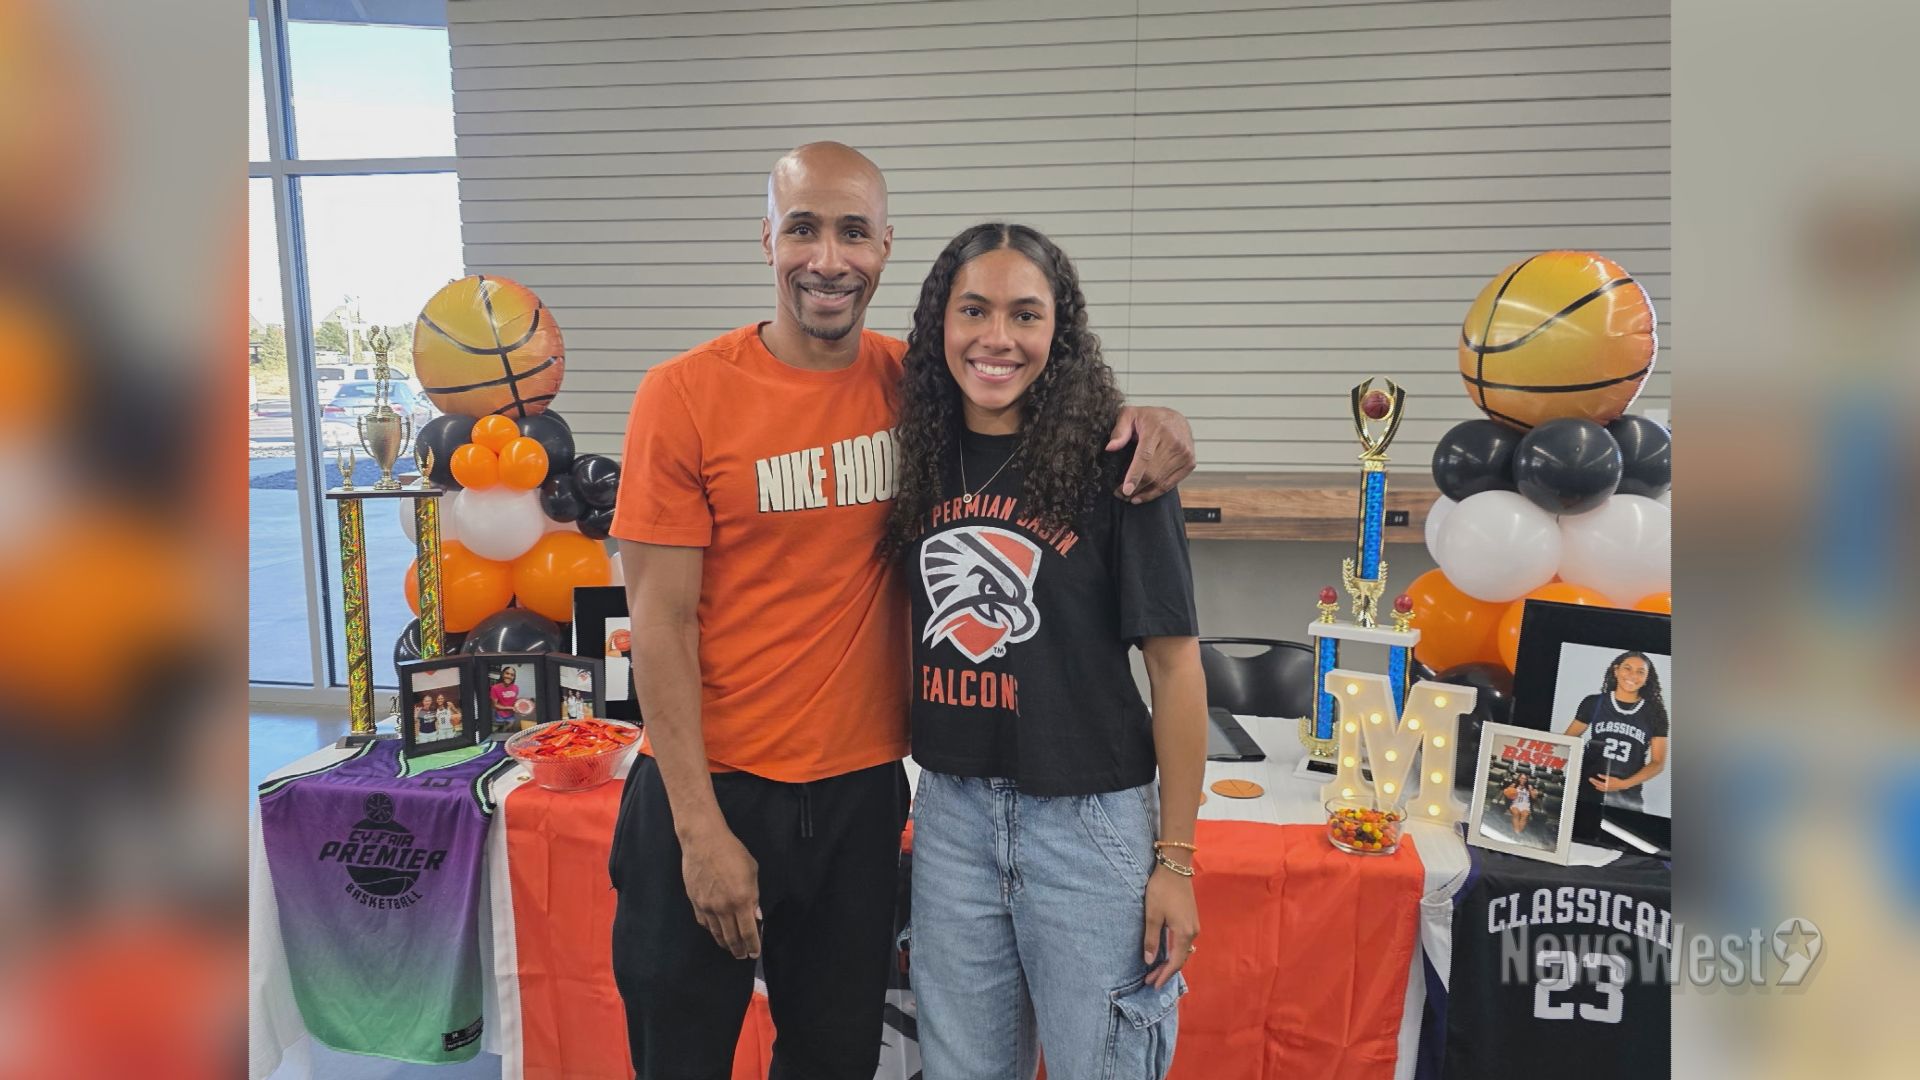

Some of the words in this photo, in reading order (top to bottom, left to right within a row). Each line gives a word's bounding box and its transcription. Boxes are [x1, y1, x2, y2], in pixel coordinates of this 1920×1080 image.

[755, 447, 828, 512] NIKE
[931, 494, 1017, 528] PERMIAN
[1516, 737, 1553, 755] THE
[1594, 720, 1646, 745] CLASSICAL
[1320, 669, 1478, 828] M
[1501, 745, 1568, 770] BASIN
[1602, 737, 1632, 763] 23
[319, 841, 448, 871] PREMIER
[345, 882, 424, 910] BASKETBALL
[1533, 949, 1627, 1024] 23
